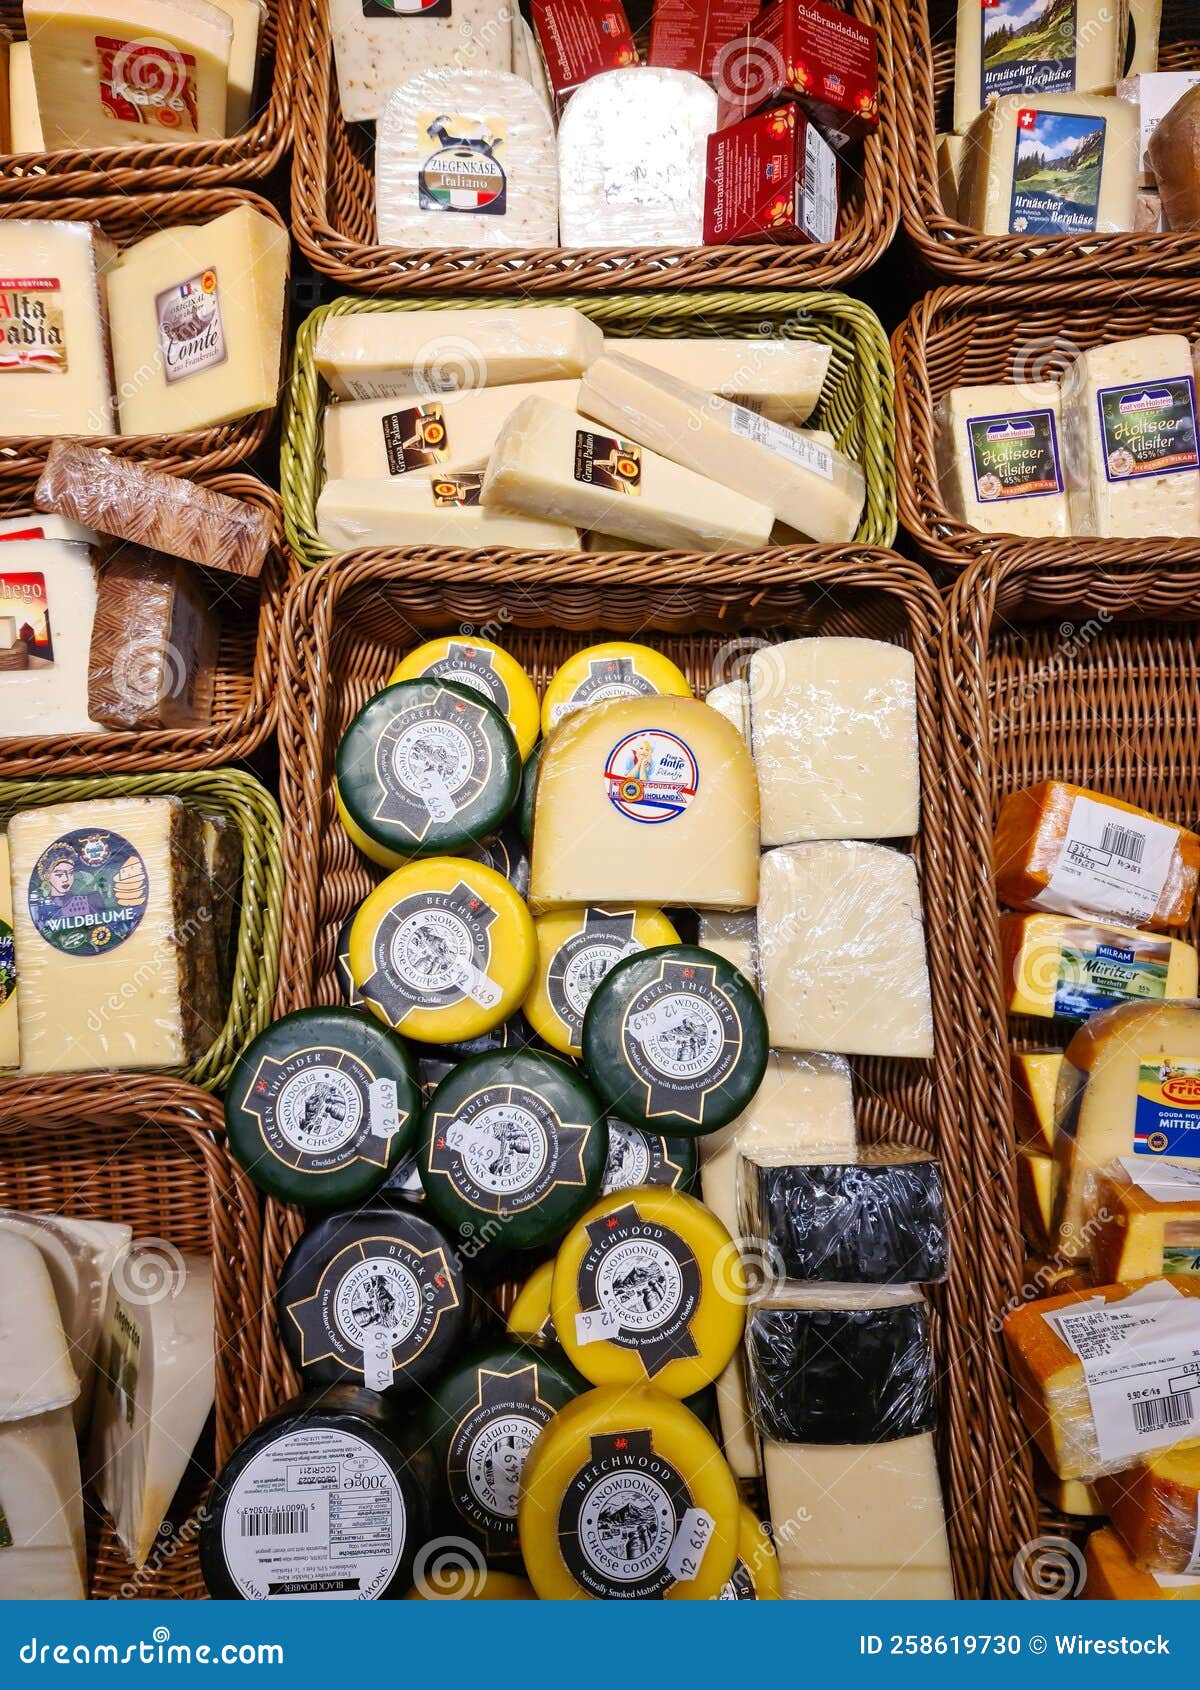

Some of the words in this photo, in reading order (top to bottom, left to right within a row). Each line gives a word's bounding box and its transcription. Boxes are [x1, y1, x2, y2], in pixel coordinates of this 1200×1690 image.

[798, 4, 869, 46] Gudbrandsdalen
[431, 158, 497, 176] ZIEGENKÄSE
[439, 174, 488, 189] Italiano
[713, 140, 725, 233] Gudbrandsdalen
[1051, 211, 1094, 225] Bergkäse
[166, 319, 219, 366] Comté
[391, 415, 402, 446] Padano
[1112, 418, 1182, 440] Holtseer
[583, 434, 594, 459] Padano
[1128, 434, 1174, 452] Tilsiter
[396, 447, 406, 472] Grana
[982, 447, 1044, 466] Holtseer
[582, 461, 593, 482] Grana
[994, 461, 1037, 478] Tilsiter
[432, 660, 500, 688] BEECHWOOD
[580, 673, 648, 697] BEECHWOOD
[402, 709, 441, 725] GREEN
[449, 713, 486, 763] THUNDER
[660, 757, 684, 770] Antje
[49, 907, 135, 932] WILDBLUME
[426, 896, 486, 953] BEECHWOOD
[1099, 947, 1132, 961] MILRAM
[455, 970, 470, 986] 12
[1083, 960, 1140, 980] Müritzer
[636, 983, 673, 1010] GREEN
[680, 980, 734, 1022] THUNDER
[268, 1053, 322, 1097] THUNDER
[459, 1094, 491, 1121] NDER
[1158, 1111, 1184, 1119] GOUDA
[265, 1105, 285, 1149] GREEN
[382, 1117, 396, 1133] 12
[449, 1131, 464, 1147] 12
[650, 1136, 662, 1169] REEN
[451, 1159, 480, 1200] GREEN
[585, 1226, 663, 1272] BEECHWOOD
[388, 1245, 427, 1276] BLACK
[415, 1281, 435, 1344] BOMBER
[640, 1333, 665, 1345] Smoked
[664, 1321, 682, 1339] Mature
[377, 1369, 390, 1386] 12
[576, 1454, 672, 1492] BEECHWOOD
[460, 1493, 514, 1533] HUNDER
[680, 1557, 698, 1577] 12
[284, 1581, 314, 1593] BOMBER
[314, 1579, 344, 1590] BLACK
[579, 1568, 608, 1596] Naturally
[608, 1587, 636, 1599] Smoked
[636, 1581, 661, 1599] Mature
